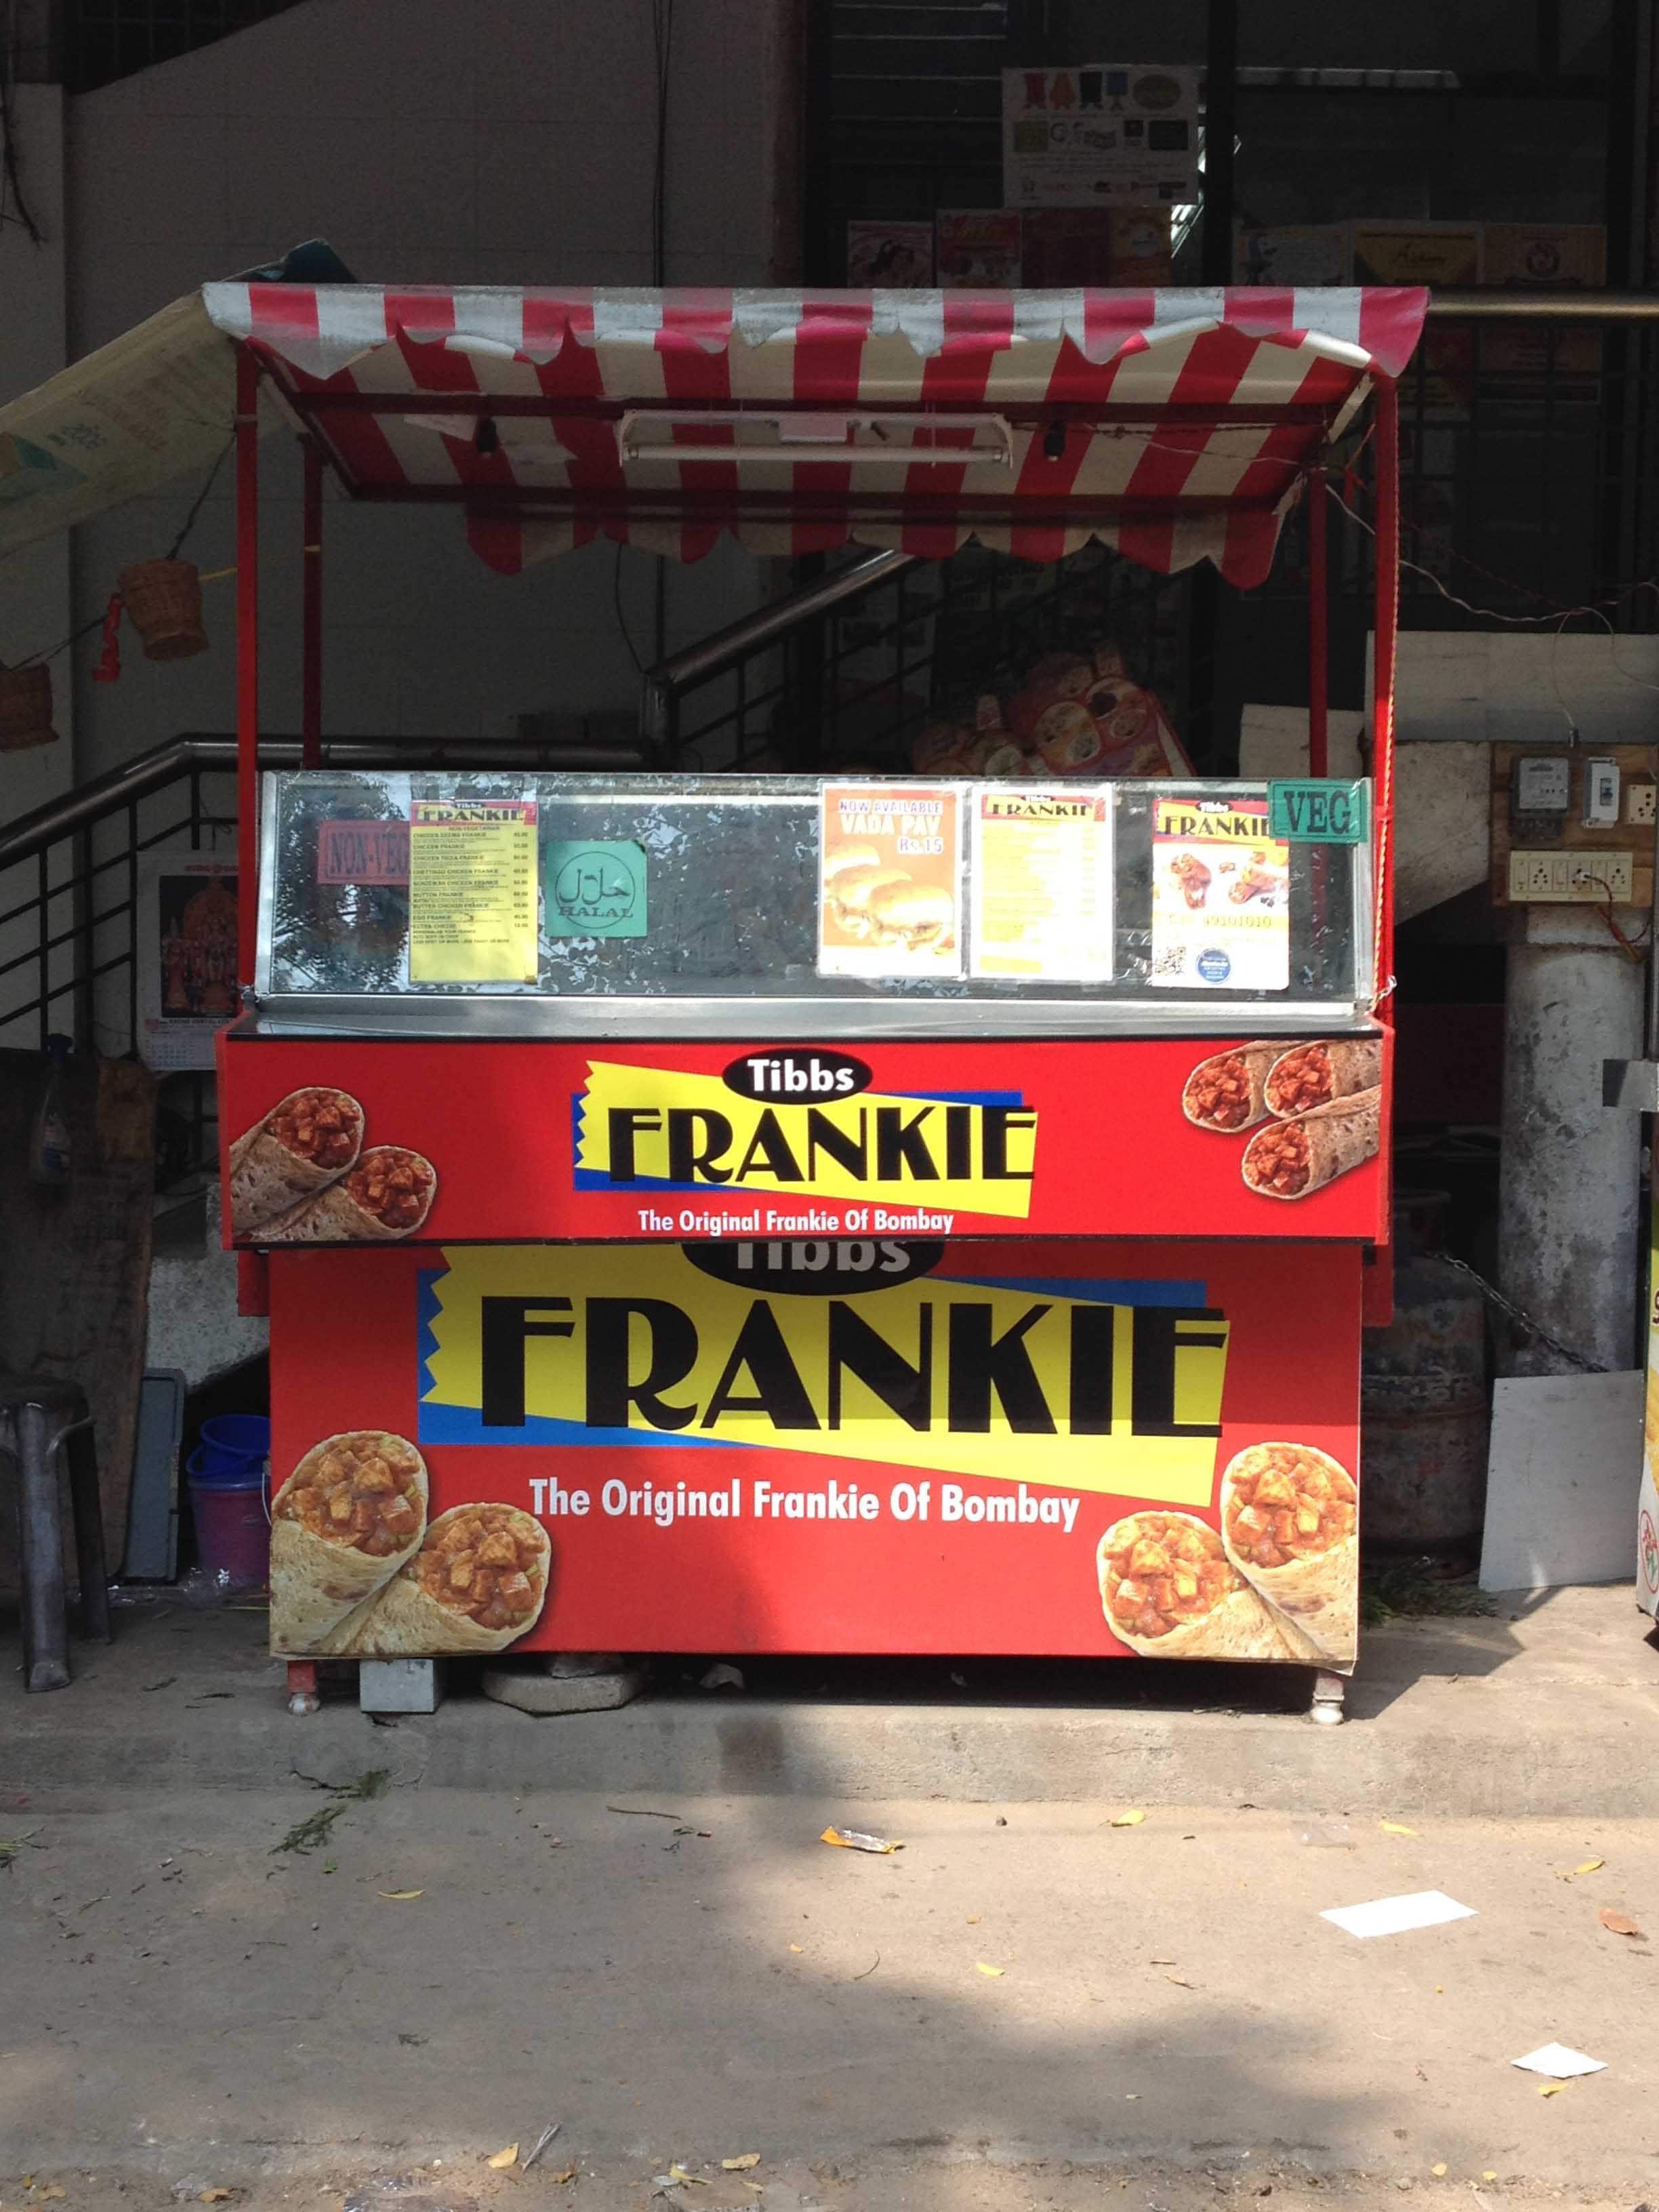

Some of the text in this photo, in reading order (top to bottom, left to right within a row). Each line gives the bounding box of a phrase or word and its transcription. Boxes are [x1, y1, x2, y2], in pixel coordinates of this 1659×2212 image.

[840, 802, 941, 813] NOW AVAILABLE
[840, 813, 941, 836] VADA PAV
[1284, 790, 1350, 834] VEG
[558, 867, 631, 905] حلال
[558, 907, 633, 918] HALAL
[747, 1059, 855, 1092] Tibbs
[609, 1105, 1037, 1183] FRANKIE
[638, 1208, 954, 1237] The Original Frankie Of Bombay
[480, 1295, 1229, 1438] FRANKIE
[529, 1477, 1080, 1534] The Original Frankie Of Bombay
